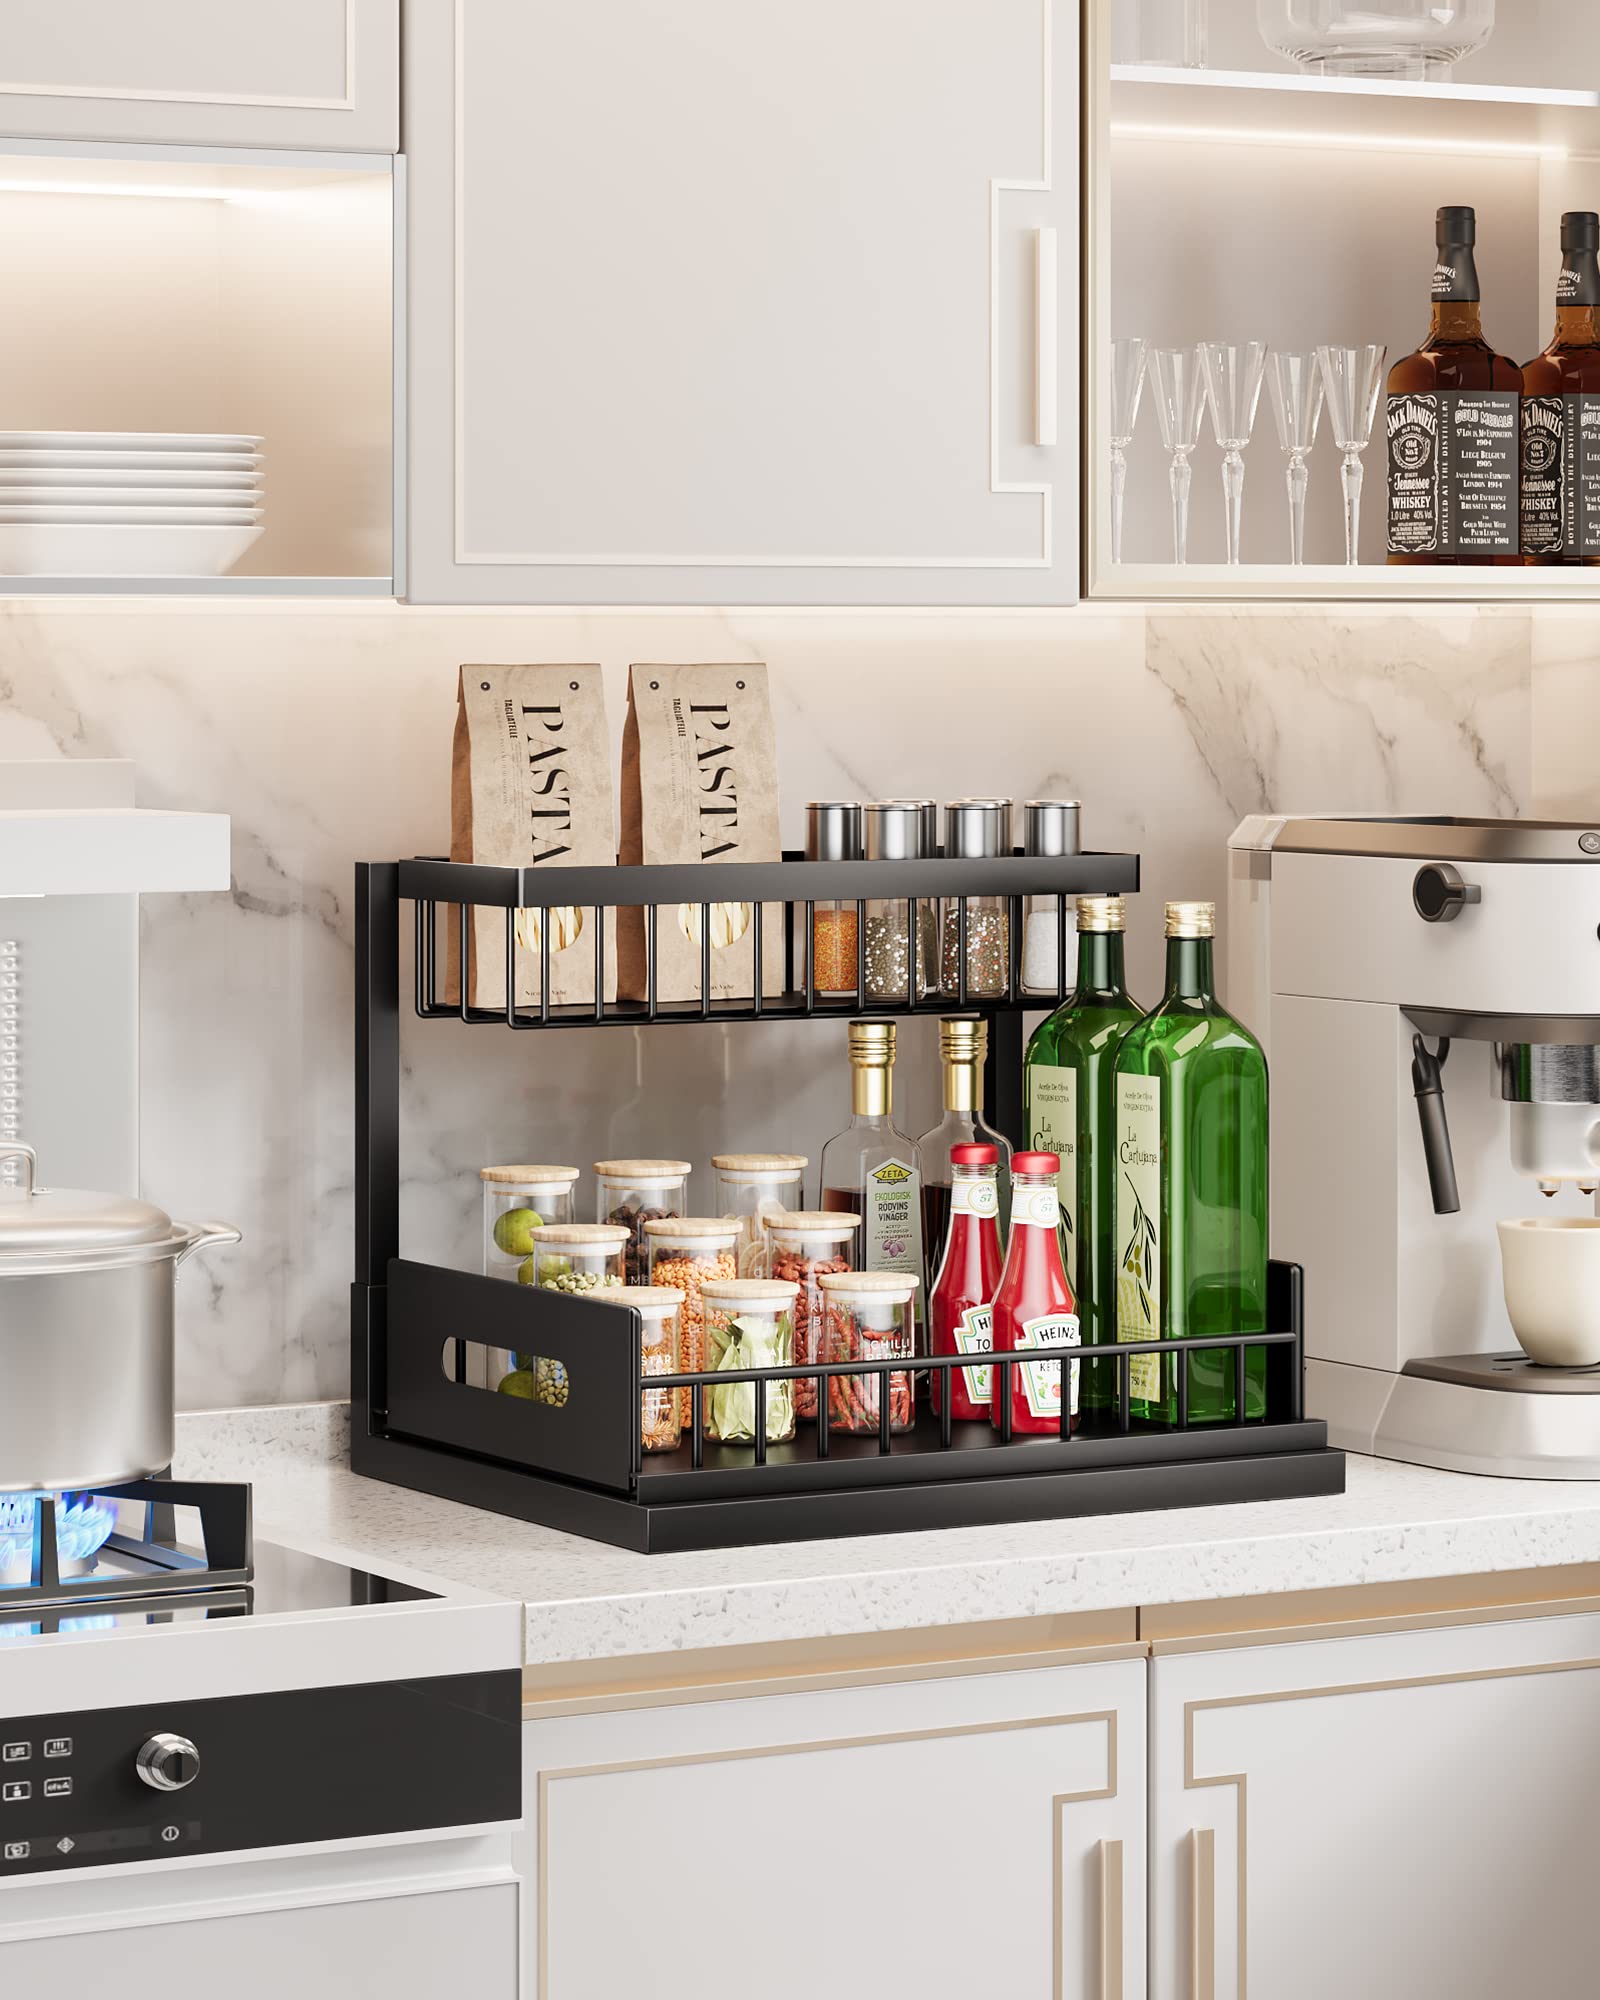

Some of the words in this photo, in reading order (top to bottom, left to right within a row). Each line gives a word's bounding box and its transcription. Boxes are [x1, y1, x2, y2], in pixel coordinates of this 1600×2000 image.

[1387, 407, 1406, 437] JACK
[1406, 400, 1438, 435] DANIEL'S
[1455, 409, 1479, 424] GOLD
[1480, 411, 1514, 428] MEDALS
[1531, 403, 1564, 438] DANIEL'S
[1461, 450, 1479, 459] LIEGE
[1480, 450, 1506, 459] BELGIUM
[1393, 472, 1430, 490] Tennessee
[1463, 480, 1486, 488] LONDON
[1442, 485, 1449, 496] AT
[1568, 487, 1574, 497] AT
[1392, 495, 1431, 509] WHISKEY
[1461, 501, 1487, 510] BRUSSELS
[1462, 520, 1477, 528] GOLD
[1459, 536, 1491, 544] AMSTERDAM
[504, 699, 518, 739] TAGLIATELLE
[672, 697, 687, 737] TAGLIATELLE
[521, 698, 573, 864] PASTA
[689, 697, 739, 861] PASTA
[1041, 1116, 1052, 1133] La
[1127, 1126, 1137, 1142] La
[1033, 1131, 1074, 1156] Cartujana
[1120, 1141, 1157, 1166] Cartujana
[881, 1169, 904, 1179] ZETA
[874, 1191, 911, 1201] EKOLOGISK
[980, 1193, 993, 1203] 57
[1040, 1203, 1054, 1212] 57
[1039, 1326, 1075, 1342] HEINZ
[870, 1337, 910, 1350] CHILLI
[641, 1354, 672, 1366] STAR
